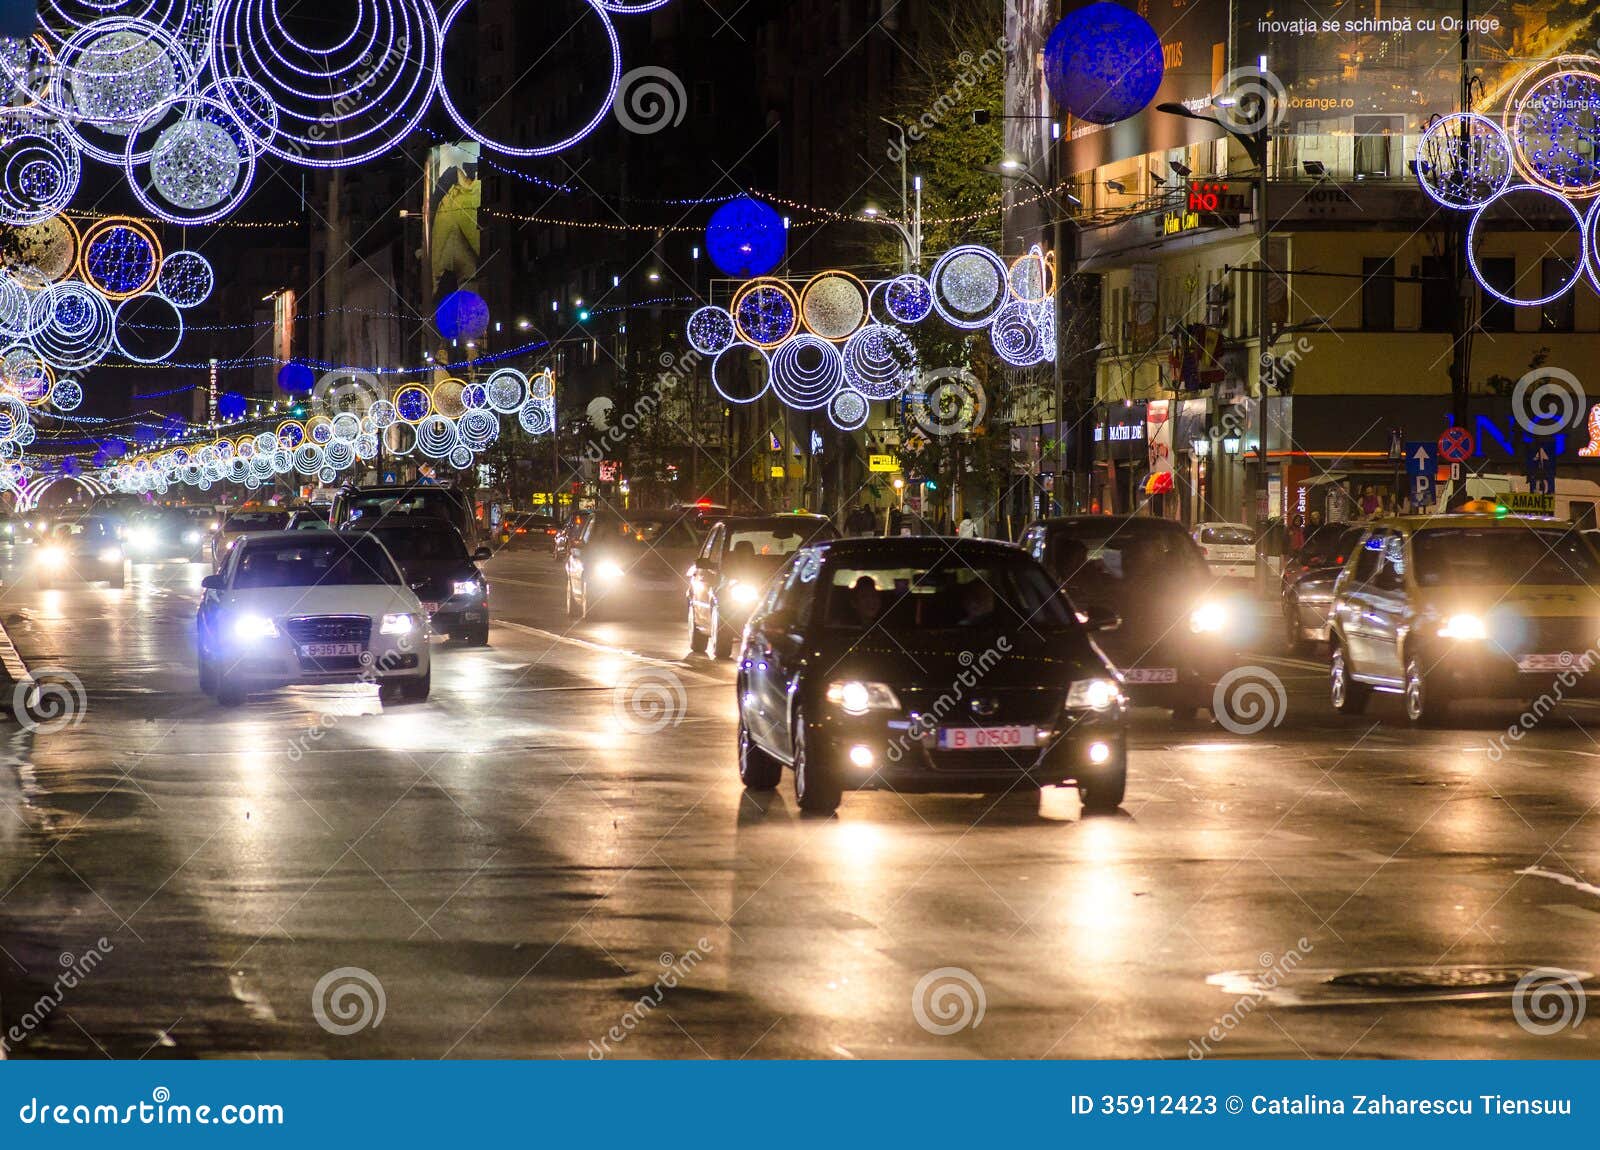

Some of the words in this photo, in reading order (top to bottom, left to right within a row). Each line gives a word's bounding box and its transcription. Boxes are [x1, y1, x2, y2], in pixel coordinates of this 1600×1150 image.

[1322, 20, 1340, 32] se
[1345, 16, 1412, 32] schimbă
[1416, 19, 1436, 31] cu
[1440, 15, 1500, 34] Ornge
[1163, 41, 1183, 70] onus
[1512, 496, 1552, 509] AMANET
[954, 730, 966, 746] B
